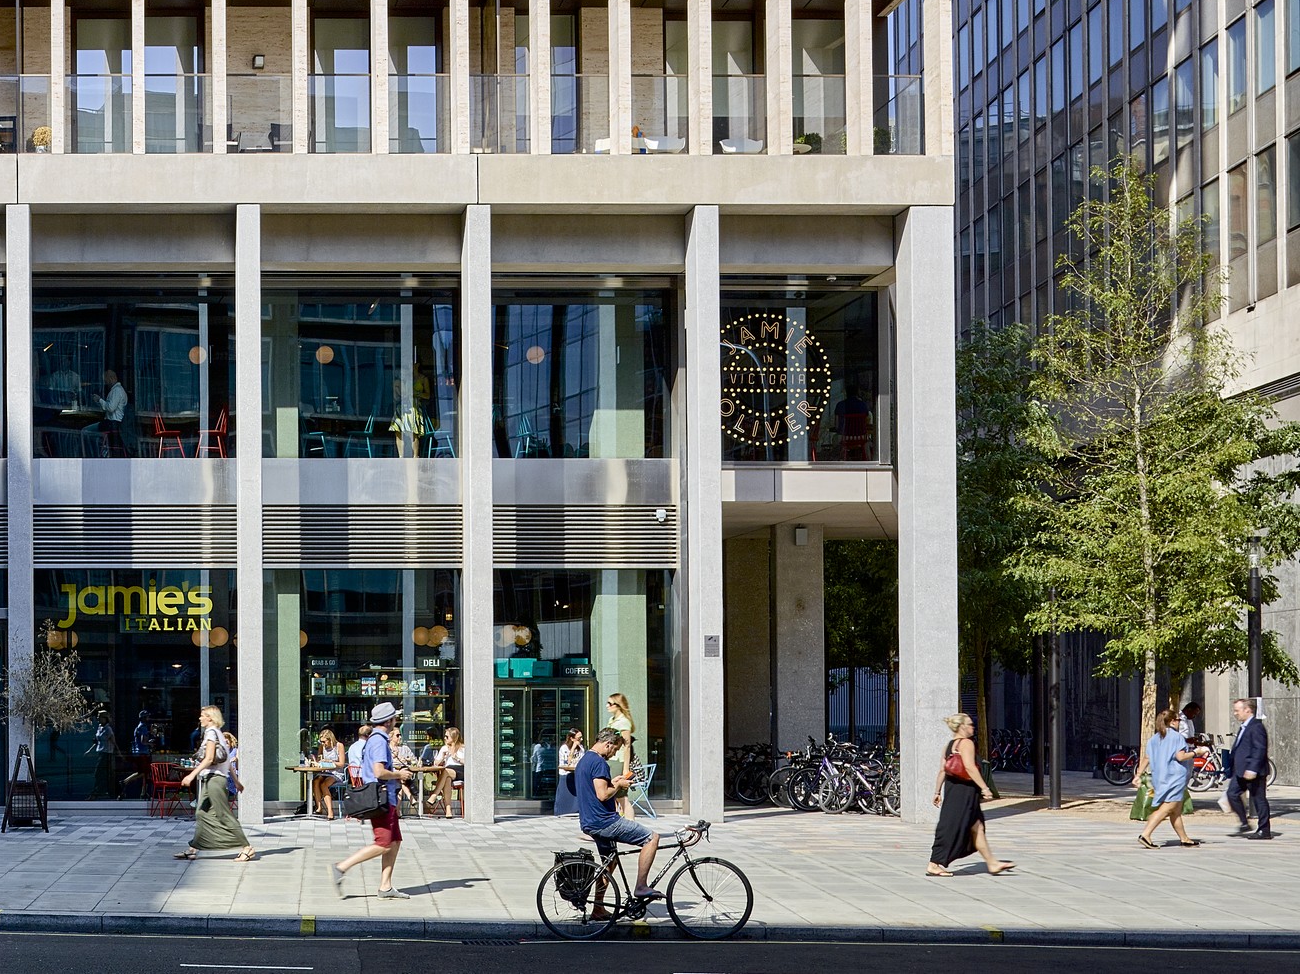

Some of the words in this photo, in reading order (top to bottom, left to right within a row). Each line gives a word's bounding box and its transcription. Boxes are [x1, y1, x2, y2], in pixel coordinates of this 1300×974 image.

[722, 321, 813, 355] JAMIE
[763, 355, 773, 363] IN
[730, 373, 806, 385] VICTORIA
[720, 398, 817, 439] OLIVER
[124, 617, 213, 631] ITALIAN
[423, 659, 440, 667] DELI
[565, 667, 590, 675] COFFEE
